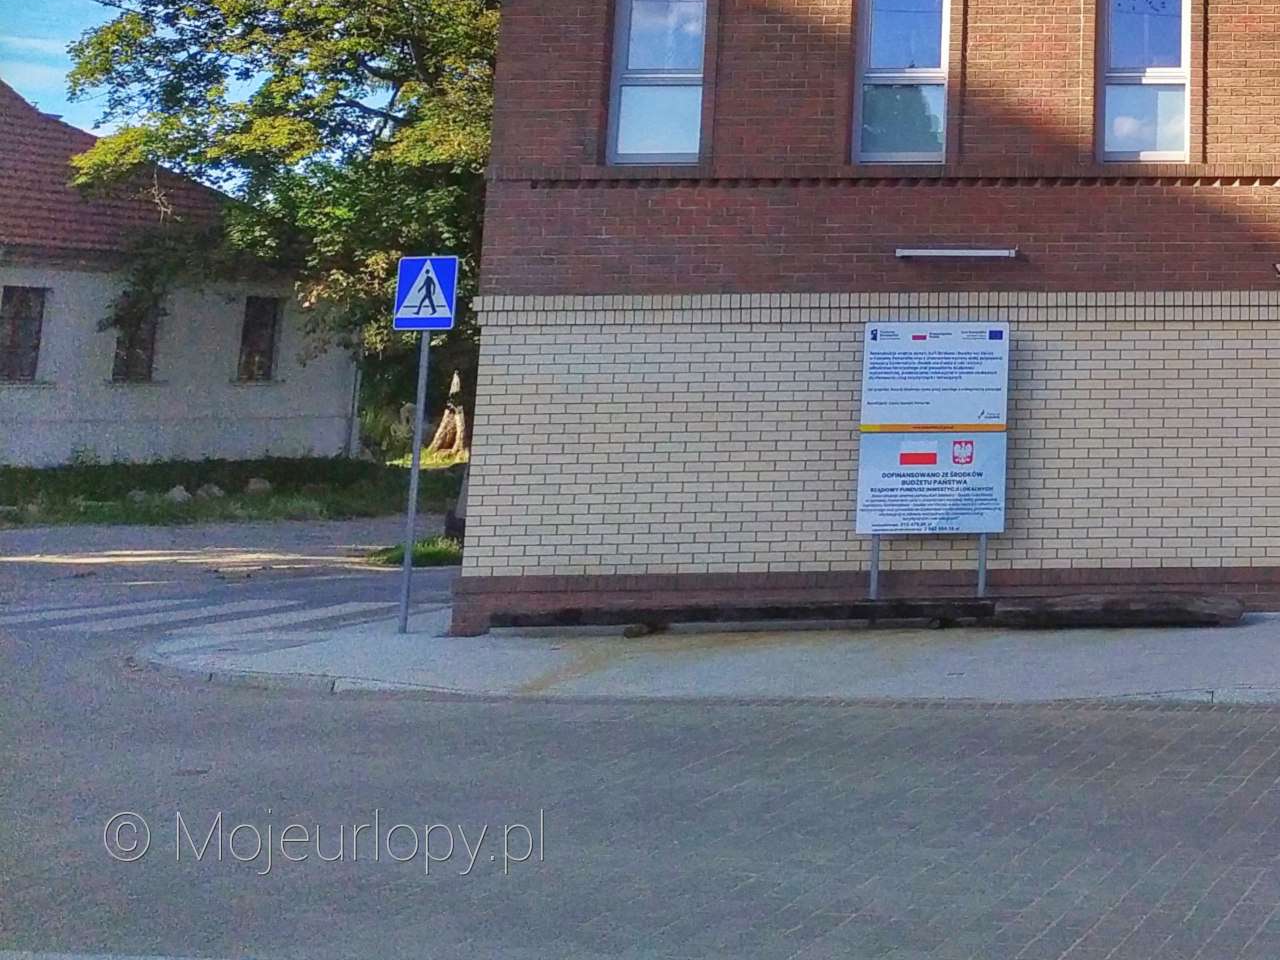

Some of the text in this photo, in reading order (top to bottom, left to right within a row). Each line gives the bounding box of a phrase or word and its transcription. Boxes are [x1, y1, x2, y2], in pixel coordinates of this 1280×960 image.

[950, 470, 984, 478] ŚRODKÓW
[901, 478, 968, 486] BUDŻETU PAŃSTWA
